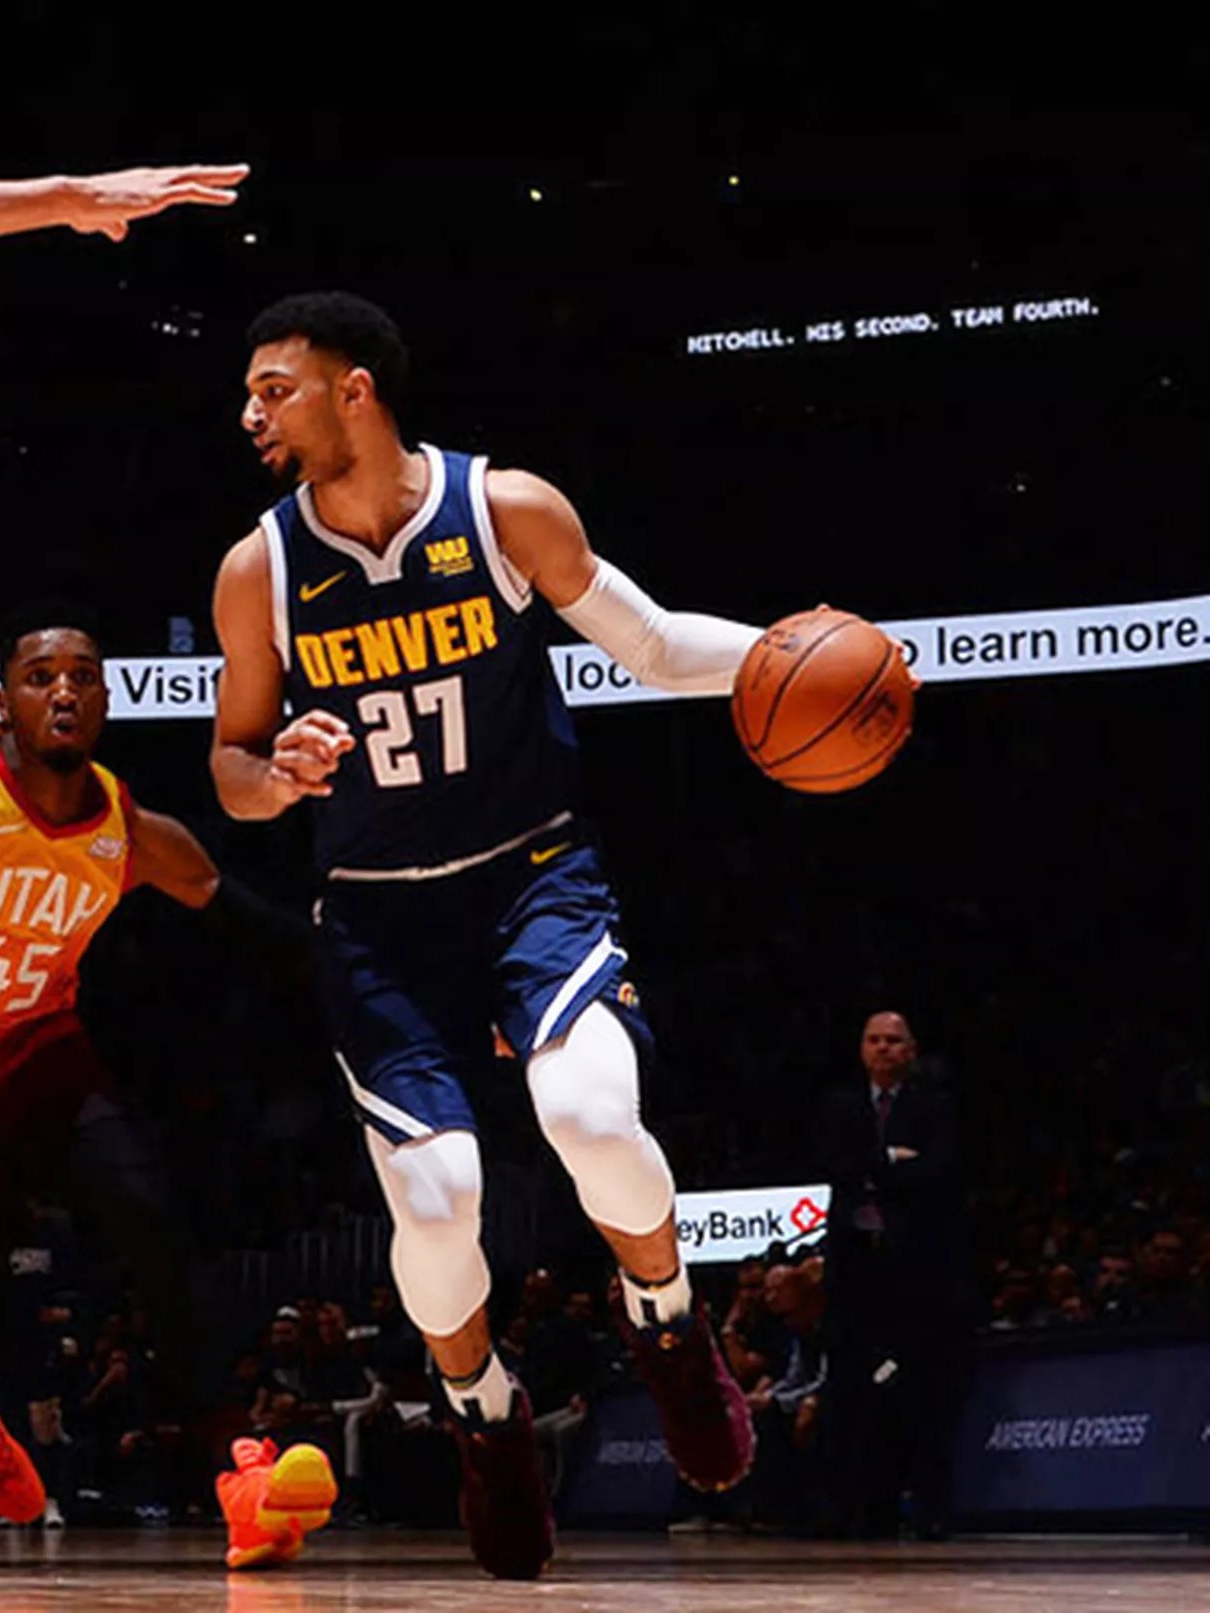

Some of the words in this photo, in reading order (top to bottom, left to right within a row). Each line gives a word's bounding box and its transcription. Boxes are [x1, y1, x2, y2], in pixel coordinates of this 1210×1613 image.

[806, 320, 845, 342] HIS
[855, 312, 939, 338] SECOND.
[951, 306, 1003, 328] TEAM
[1013, 297, 1099, 322] FOURTH.
[295, 596, 498, 688] DENVER
[565, 653, 641, 690] loc
[936, 626, 1058, 666] learn
[1077, 616, 1210, 656] more.
[357, 675, 467, 787] 27
[677, 1209, 784, 1247] eyBank
